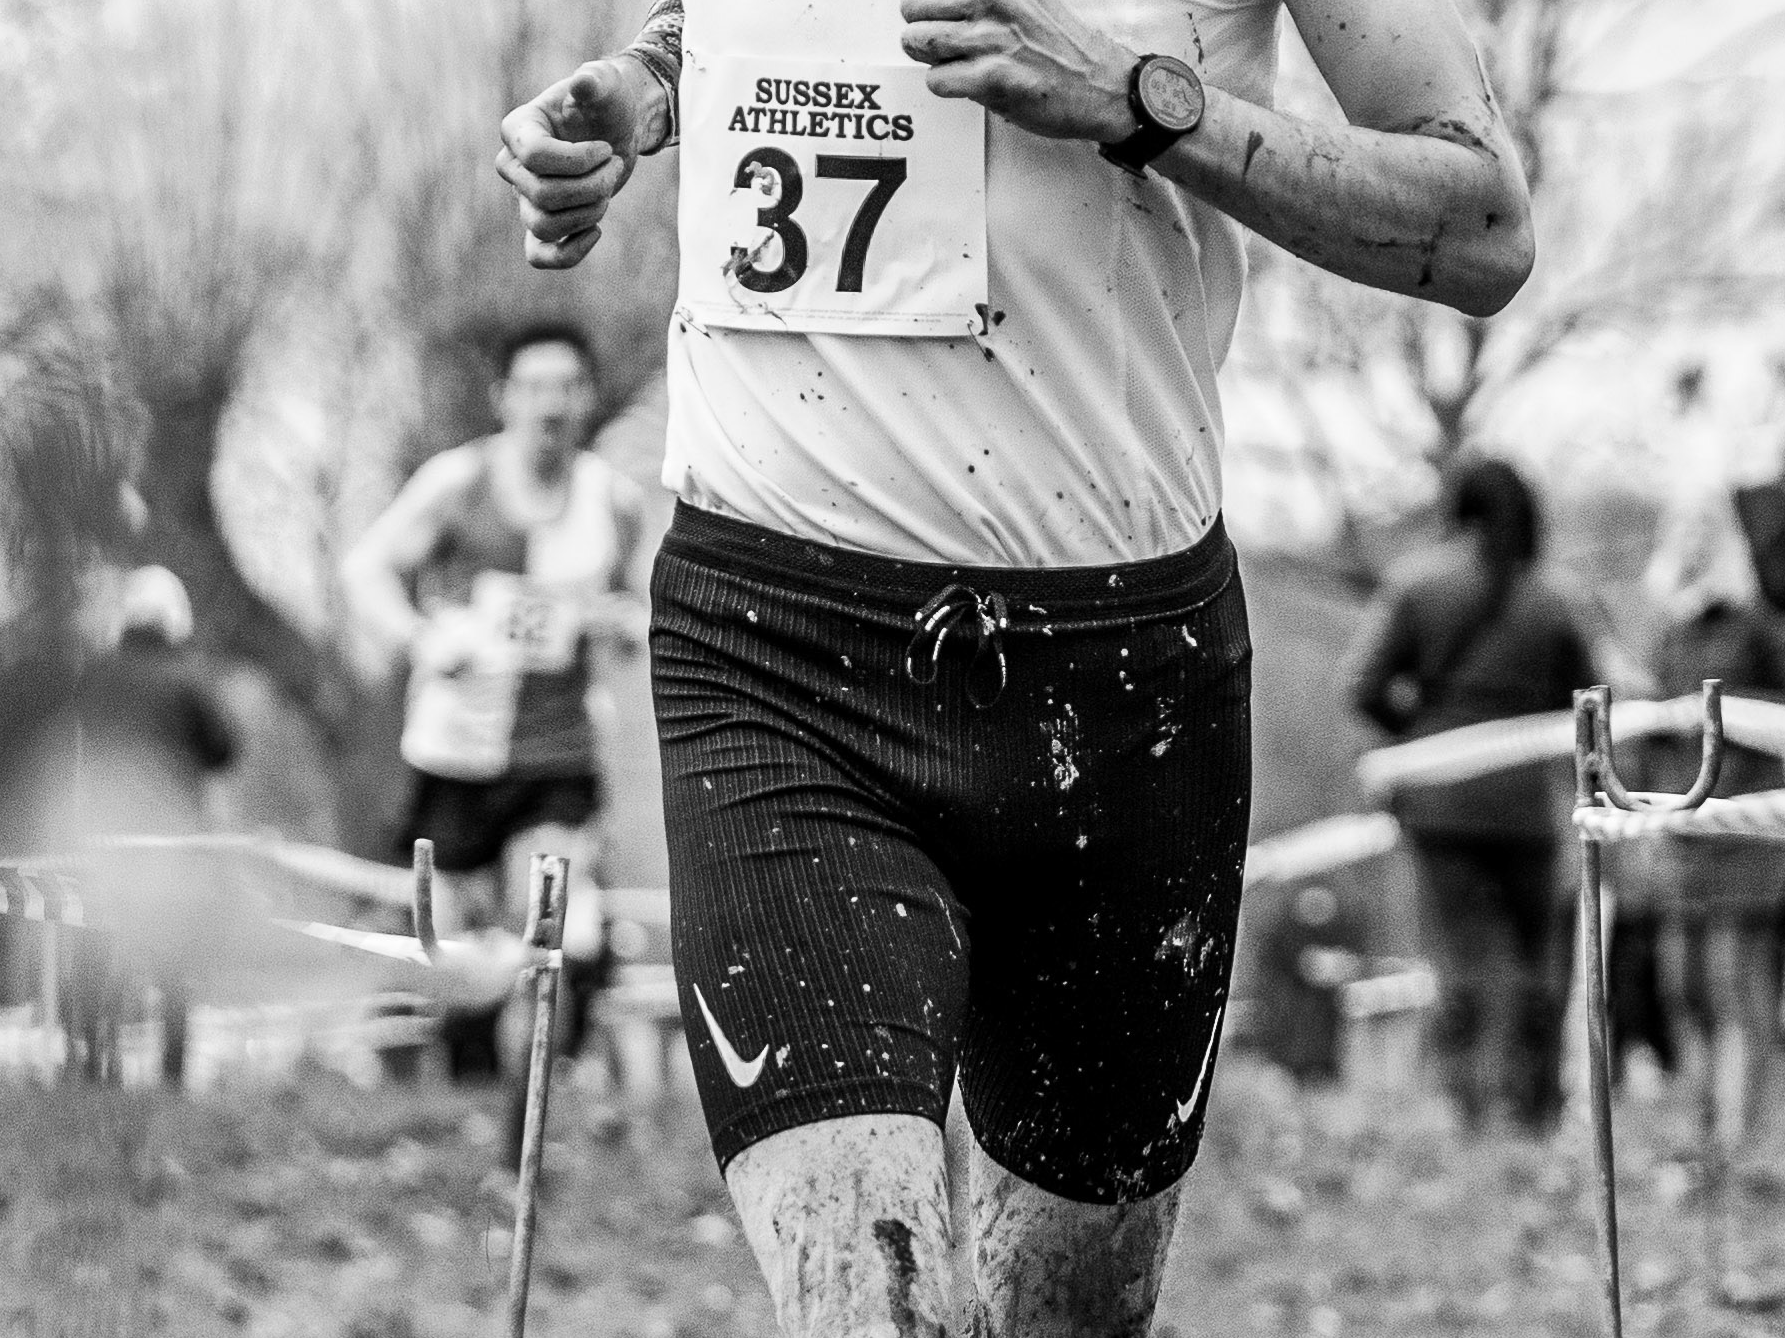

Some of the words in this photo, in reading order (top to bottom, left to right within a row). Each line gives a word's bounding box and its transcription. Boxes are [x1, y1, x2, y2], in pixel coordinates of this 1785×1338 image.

[755, 77, 881, 110] SUSSEX
[728, 106, 914, 141] ATHLETICS
[729, 146, 908, 294] 37
